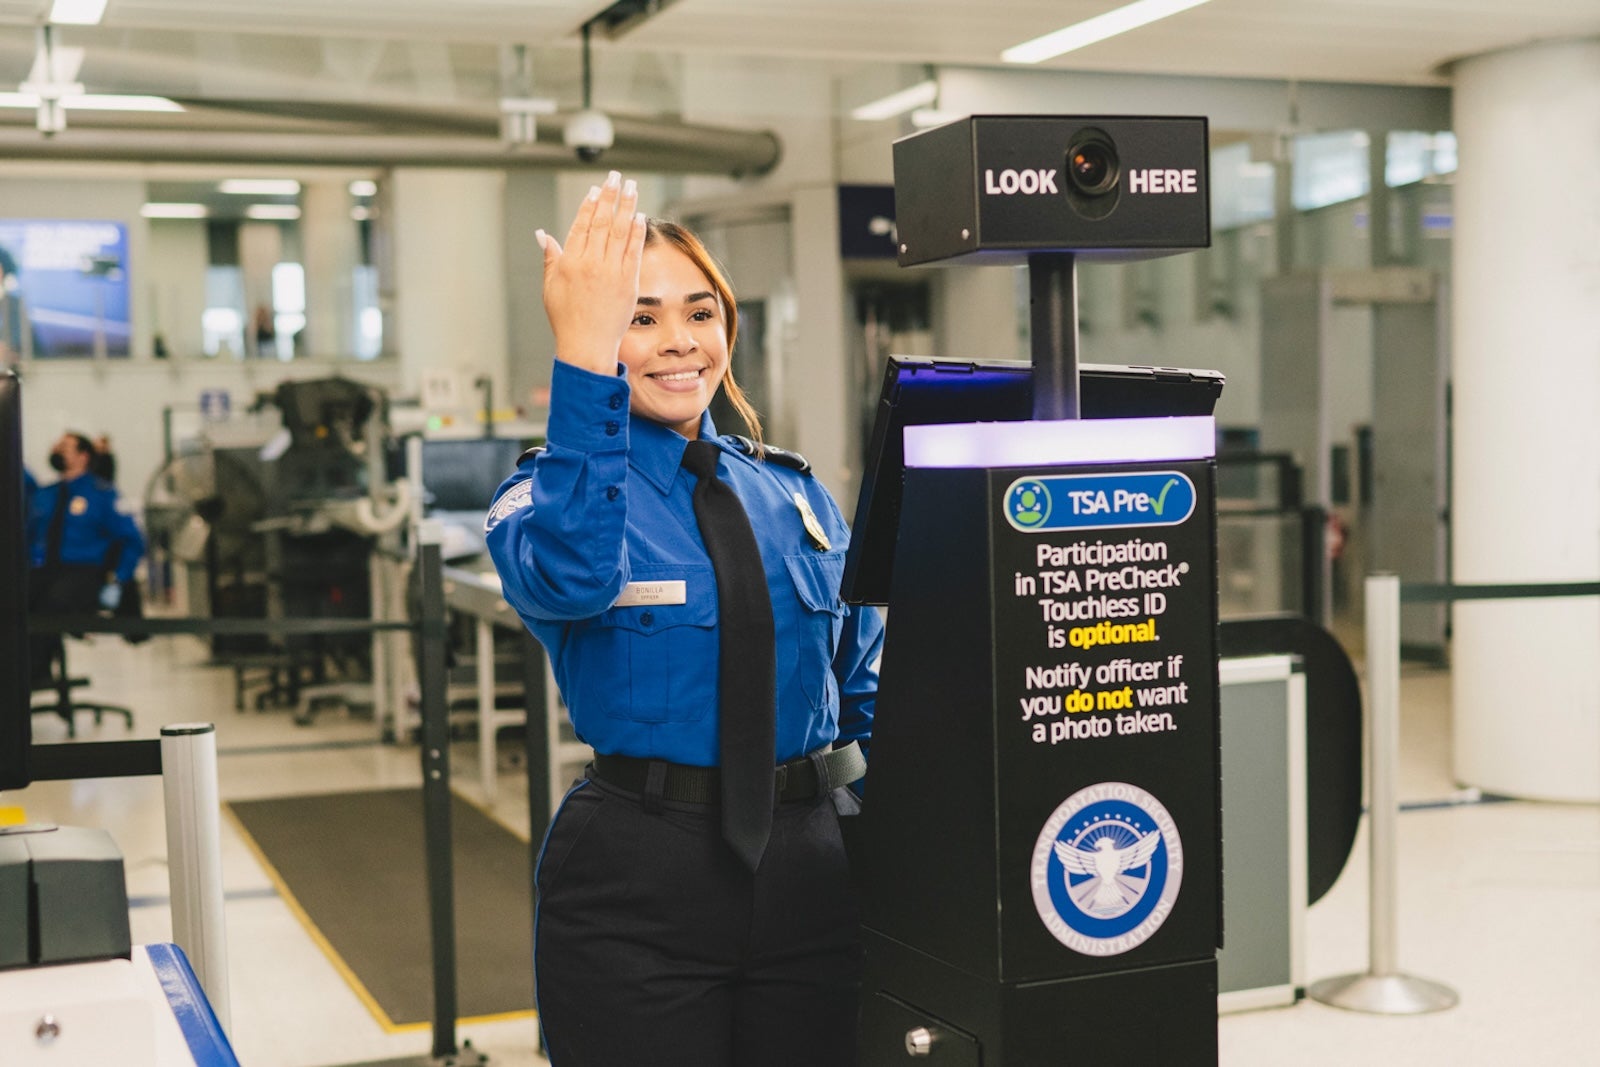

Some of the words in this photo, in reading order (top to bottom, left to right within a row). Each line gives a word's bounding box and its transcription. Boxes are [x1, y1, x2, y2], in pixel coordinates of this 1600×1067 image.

[984, 168, 1059, 195] LOOK
[1129, 168, 1198, 194] HERE
[1068, 490, 1111, 515] TSA
[1036, 538, 1167, 567] Participation
[635, 586, 663, 594] BONILLA
[1015, 572, 1036, 596] in
[1039, 570, 1082, 595] TSA
[1038, 595, 1140, 622] Touchless
[1143, 592, 1167, 616] ID
[1047, 625, 1067, 649] is
[1069, 618, 1160, 650] optional.
[1025, 662, 1092, 690] Notify
[1095, 658, 1163, 685] officer
[1167, 655, 1184, 679] if
[1020, 694, 1062, 721] you
[1065, 689, 1094, 713] do
[1097, 686, 1133, 710] not
[1136, 682, 1188, 707] want
[1032, 722, 1047, 743] a
[1051, 715, 1112, 745] photo
[1115, 711, 1178, 735] taken.
[1034, 785, 1137, 889] TRANSPORTATION
[1140, 797, 1181, 872] SECURITY
[1042, 899, 1172, 955] ADMINISTRATION
